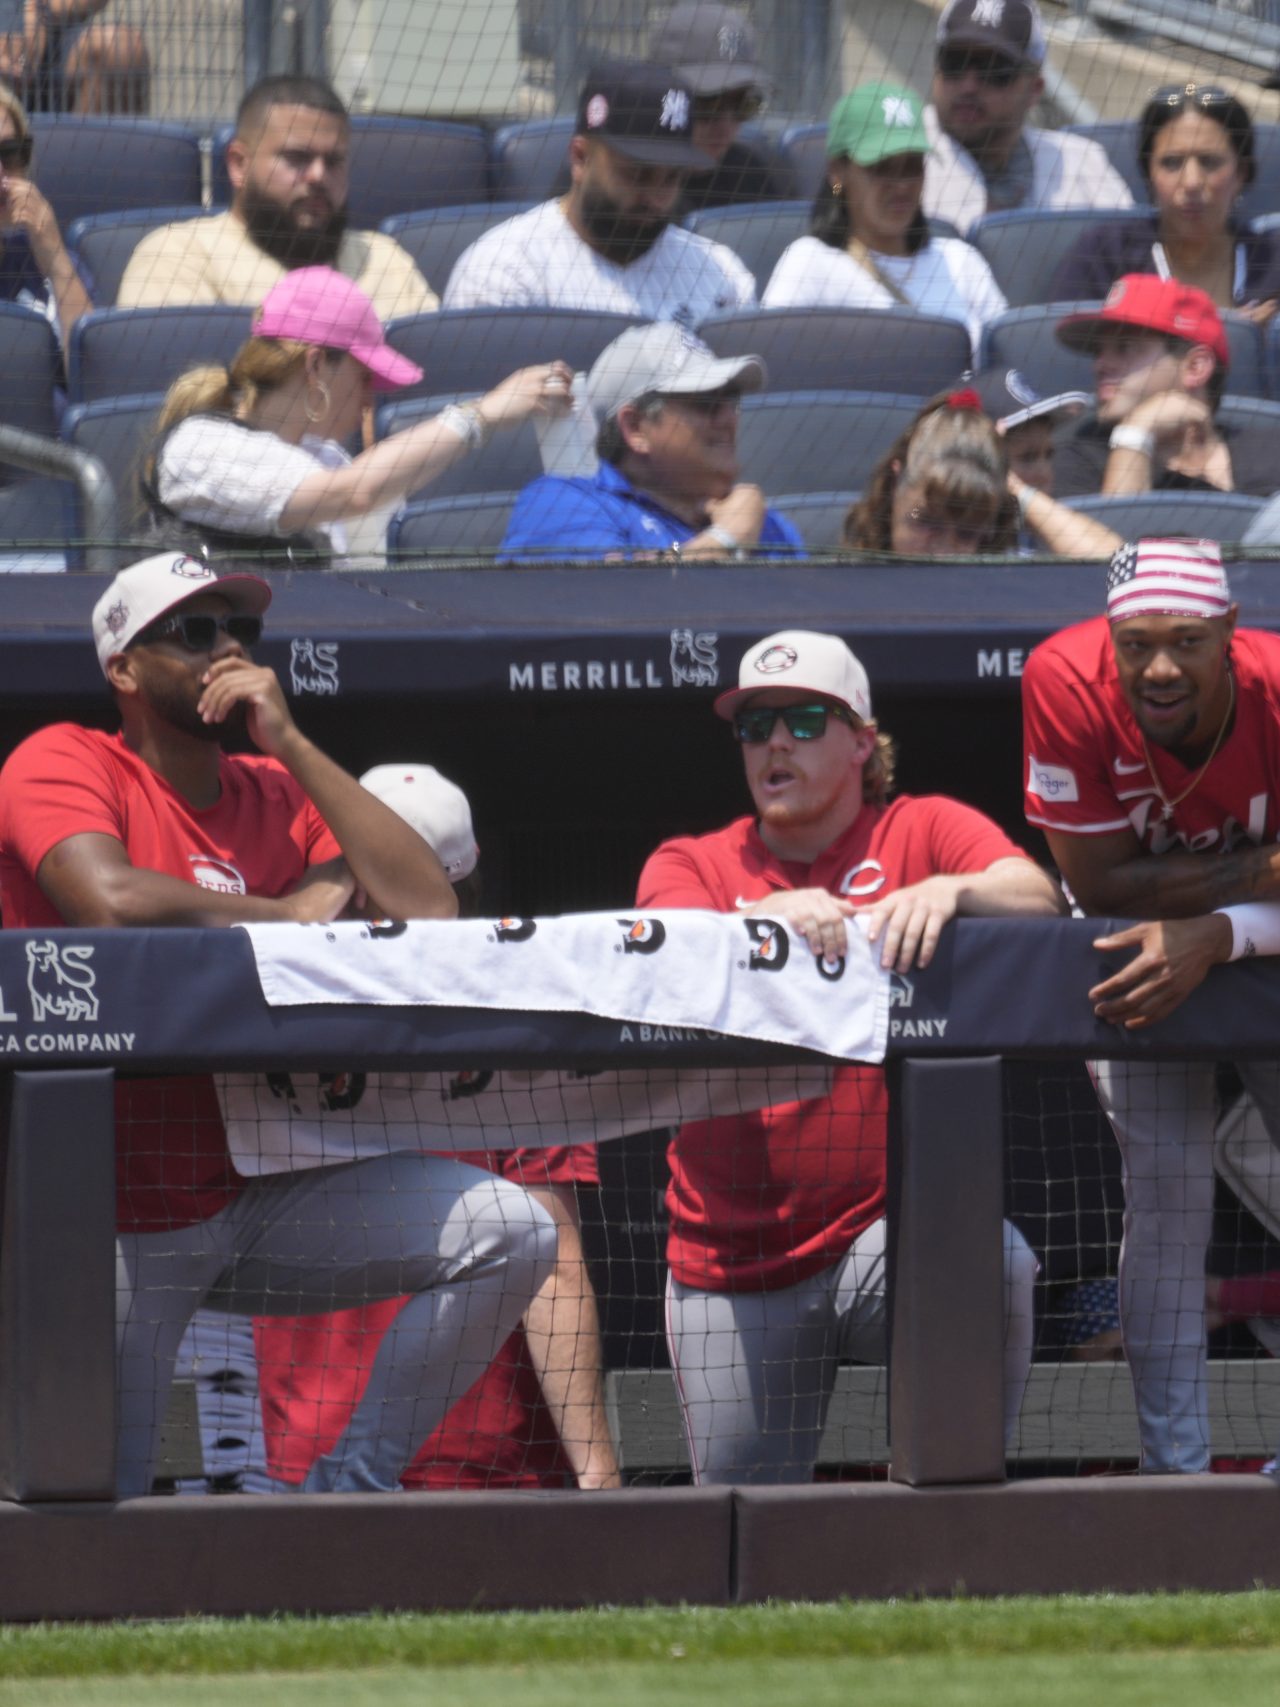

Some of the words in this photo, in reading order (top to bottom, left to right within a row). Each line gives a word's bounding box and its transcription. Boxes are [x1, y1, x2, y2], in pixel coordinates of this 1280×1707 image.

[509, 660, 662, 691] MERRILL
[840, 859, 886, 896] C
[890, 1019, 948, 1038] PANY
[25, 1033, 136, 1052] COMPANY
